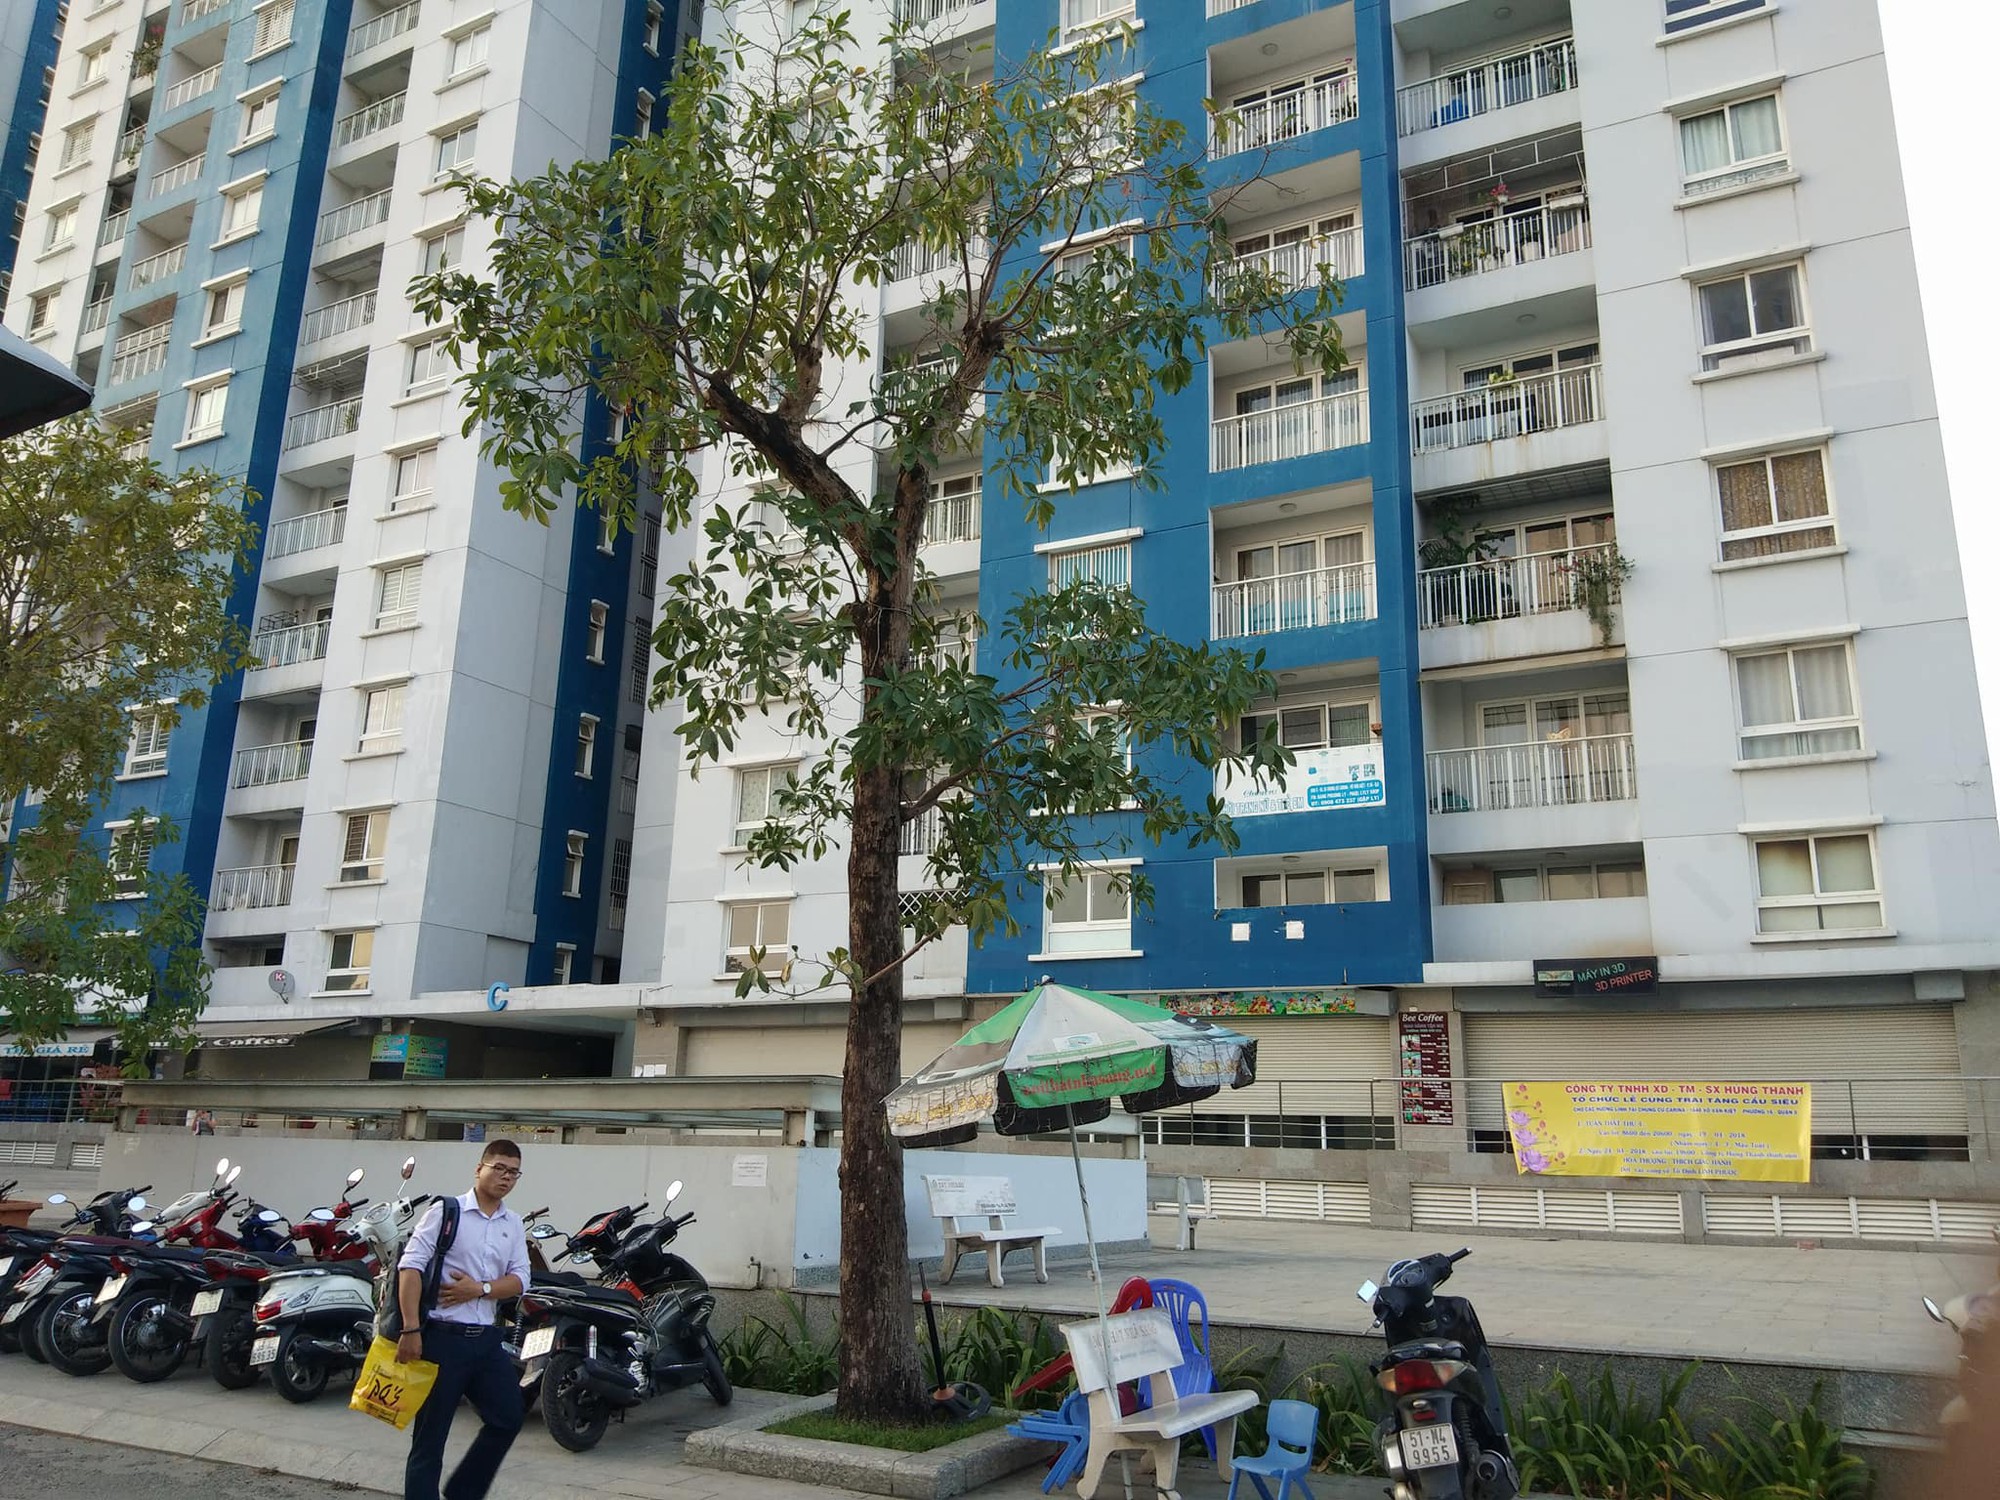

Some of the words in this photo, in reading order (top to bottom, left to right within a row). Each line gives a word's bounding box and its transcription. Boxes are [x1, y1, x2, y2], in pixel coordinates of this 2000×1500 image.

[1577, 968, 1597, 983] MÁY
[1599, 966, 1610, 978] IN
[1611, 962, 1626, 974] 3D
[1595, 980, 1608, 992] 3D
[1610, 969, 1654, 988] PRINTER
[1402, 1013, 1416, 1022] Bee
[1418, 1013, 1444, 1023] Coffee
[213, 1036, 290, 1047] Coffee
[1600, 1085, 1614, 1093] TY
[1618, 1085, 1649, 1094] TNHH
[1653, 1085, 1669, 1094] XD
[1679, 1085, 1695, 1094] TM
[1705, 1085, 1720, 1094] SX
[1762, 1086, 1804, 1096] THANH
[1412, 1445, 1450, 1465] 9955
